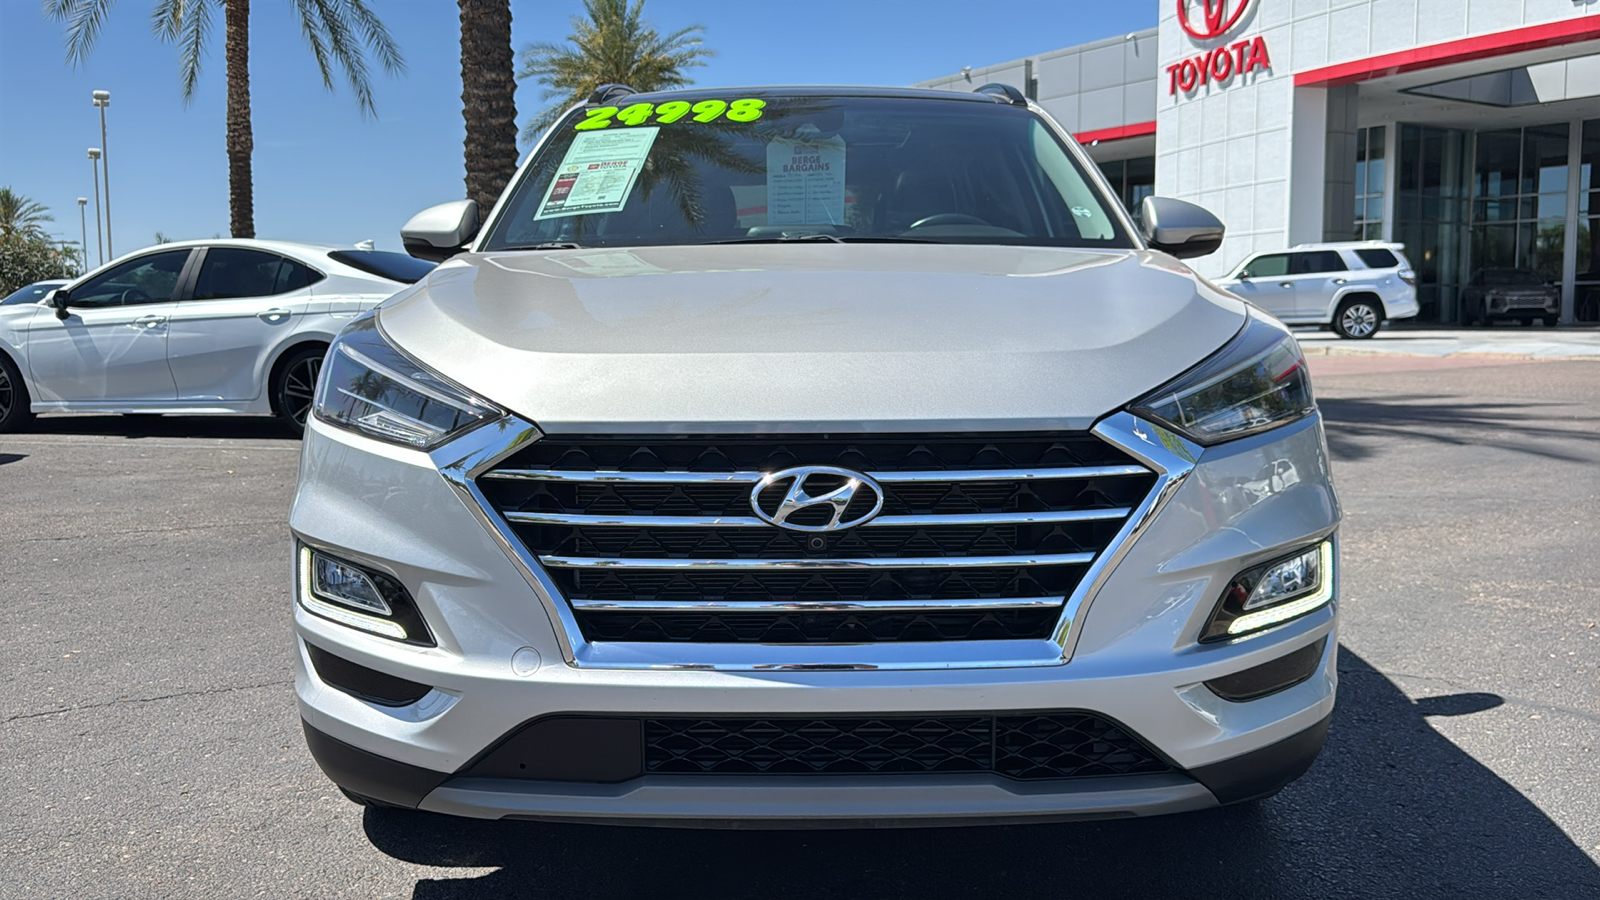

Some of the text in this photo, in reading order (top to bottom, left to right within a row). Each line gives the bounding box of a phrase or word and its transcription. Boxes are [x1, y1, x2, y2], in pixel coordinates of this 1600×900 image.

[1165, 36, 1270, 97] TOYOTA
[574, 98, 767, 131] 24998
[782, 162, 831, 173] BARGAINS
[791, 155, 822, 165] BERGE
